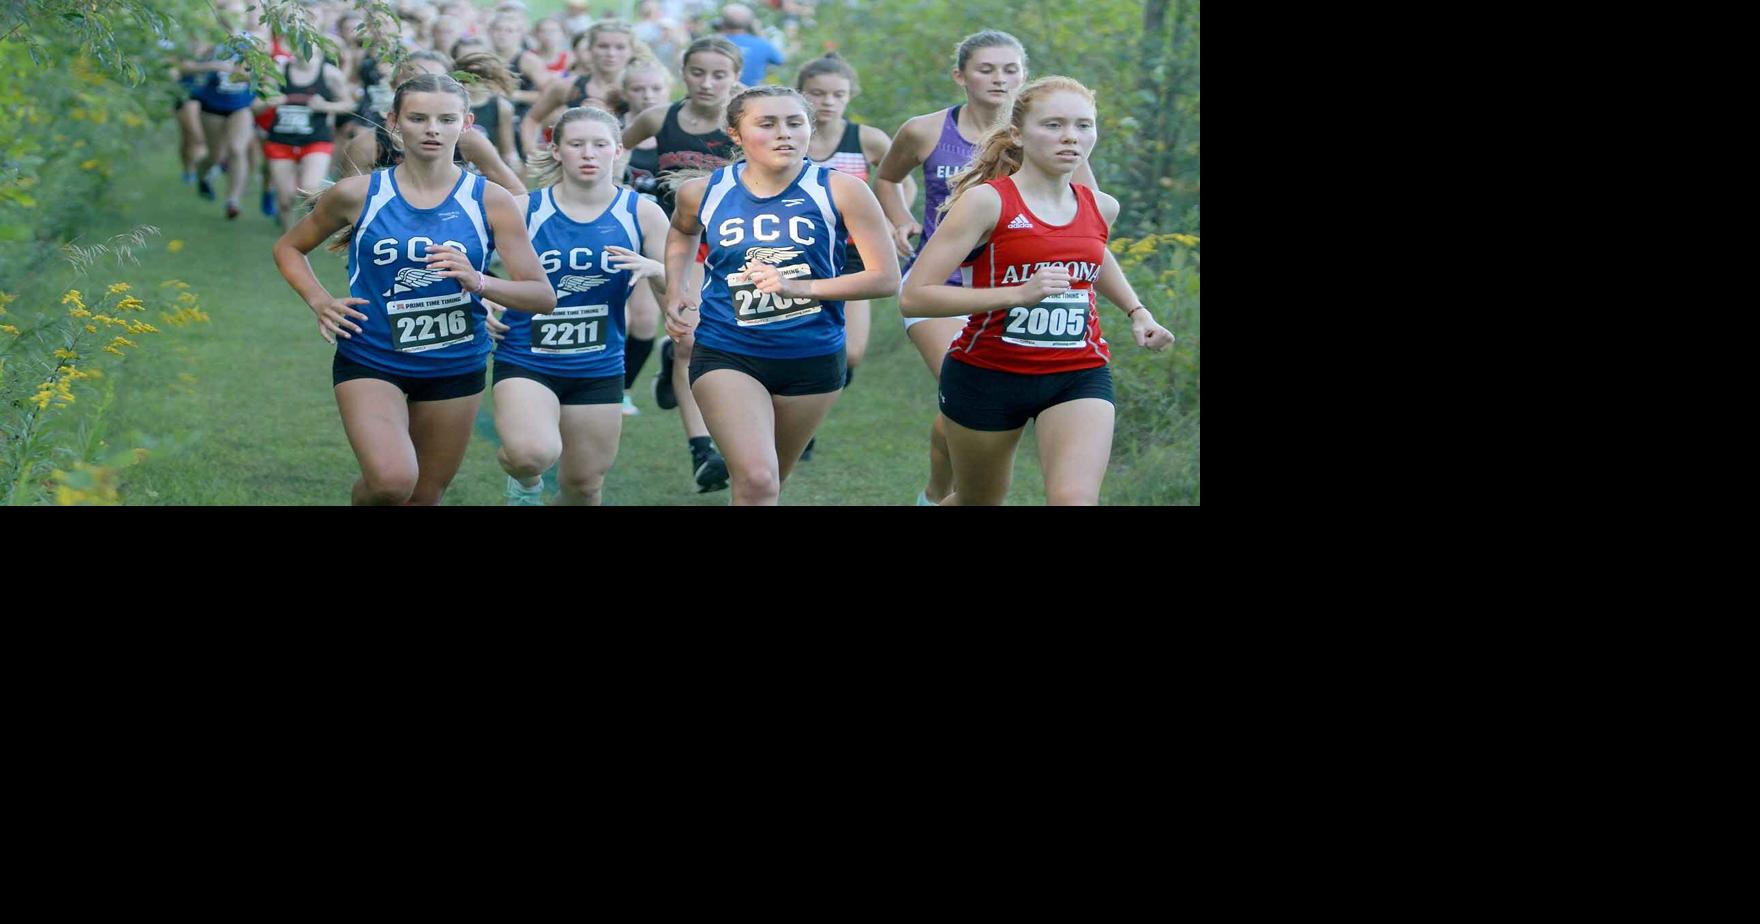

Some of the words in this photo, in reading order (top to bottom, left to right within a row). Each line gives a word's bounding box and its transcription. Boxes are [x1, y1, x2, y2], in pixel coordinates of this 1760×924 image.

[719, 214, 816, 247] SCC
[405, 301, 424, 309] PRIME
[441, 296, 462, 305] TIMING
[397, 309, 467, 343] 2216
[541, 320, 599, 346] 2211
[1006, 306, 1085, 336] 2005
